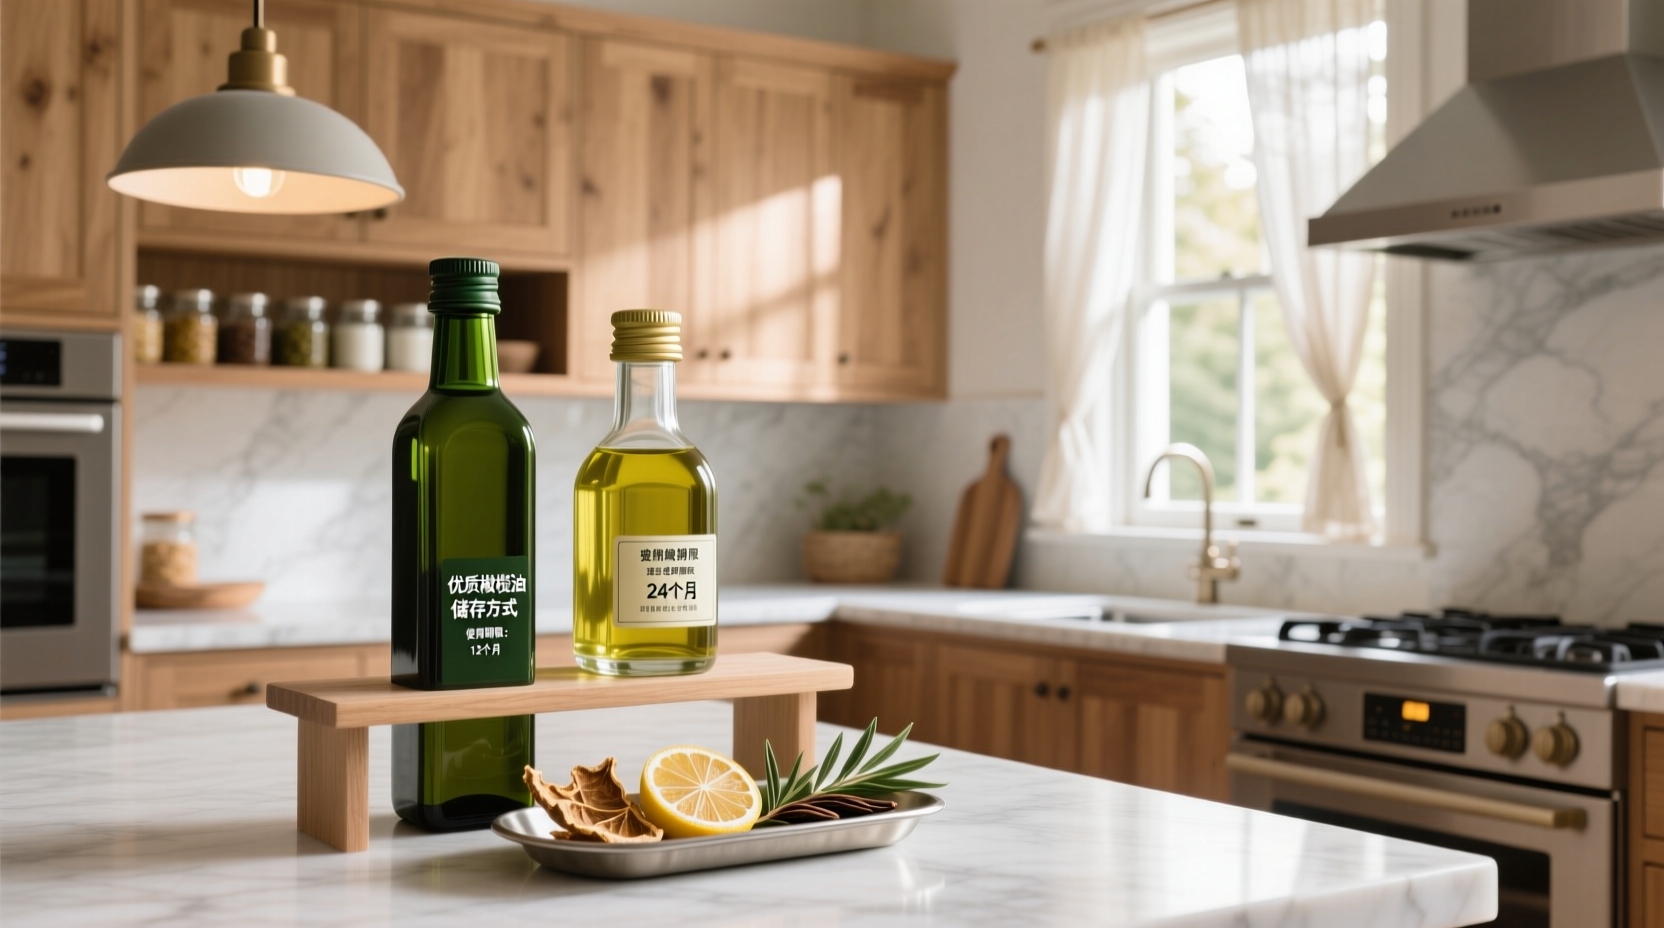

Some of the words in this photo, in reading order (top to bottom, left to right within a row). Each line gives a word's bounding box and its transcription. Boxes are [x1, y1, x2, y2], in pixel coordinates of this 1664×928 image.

[646, 581, 697, 600] 24个月
[450, 598, 519, 620] 储存方式
[470, 643, 501, 656] 12个月
